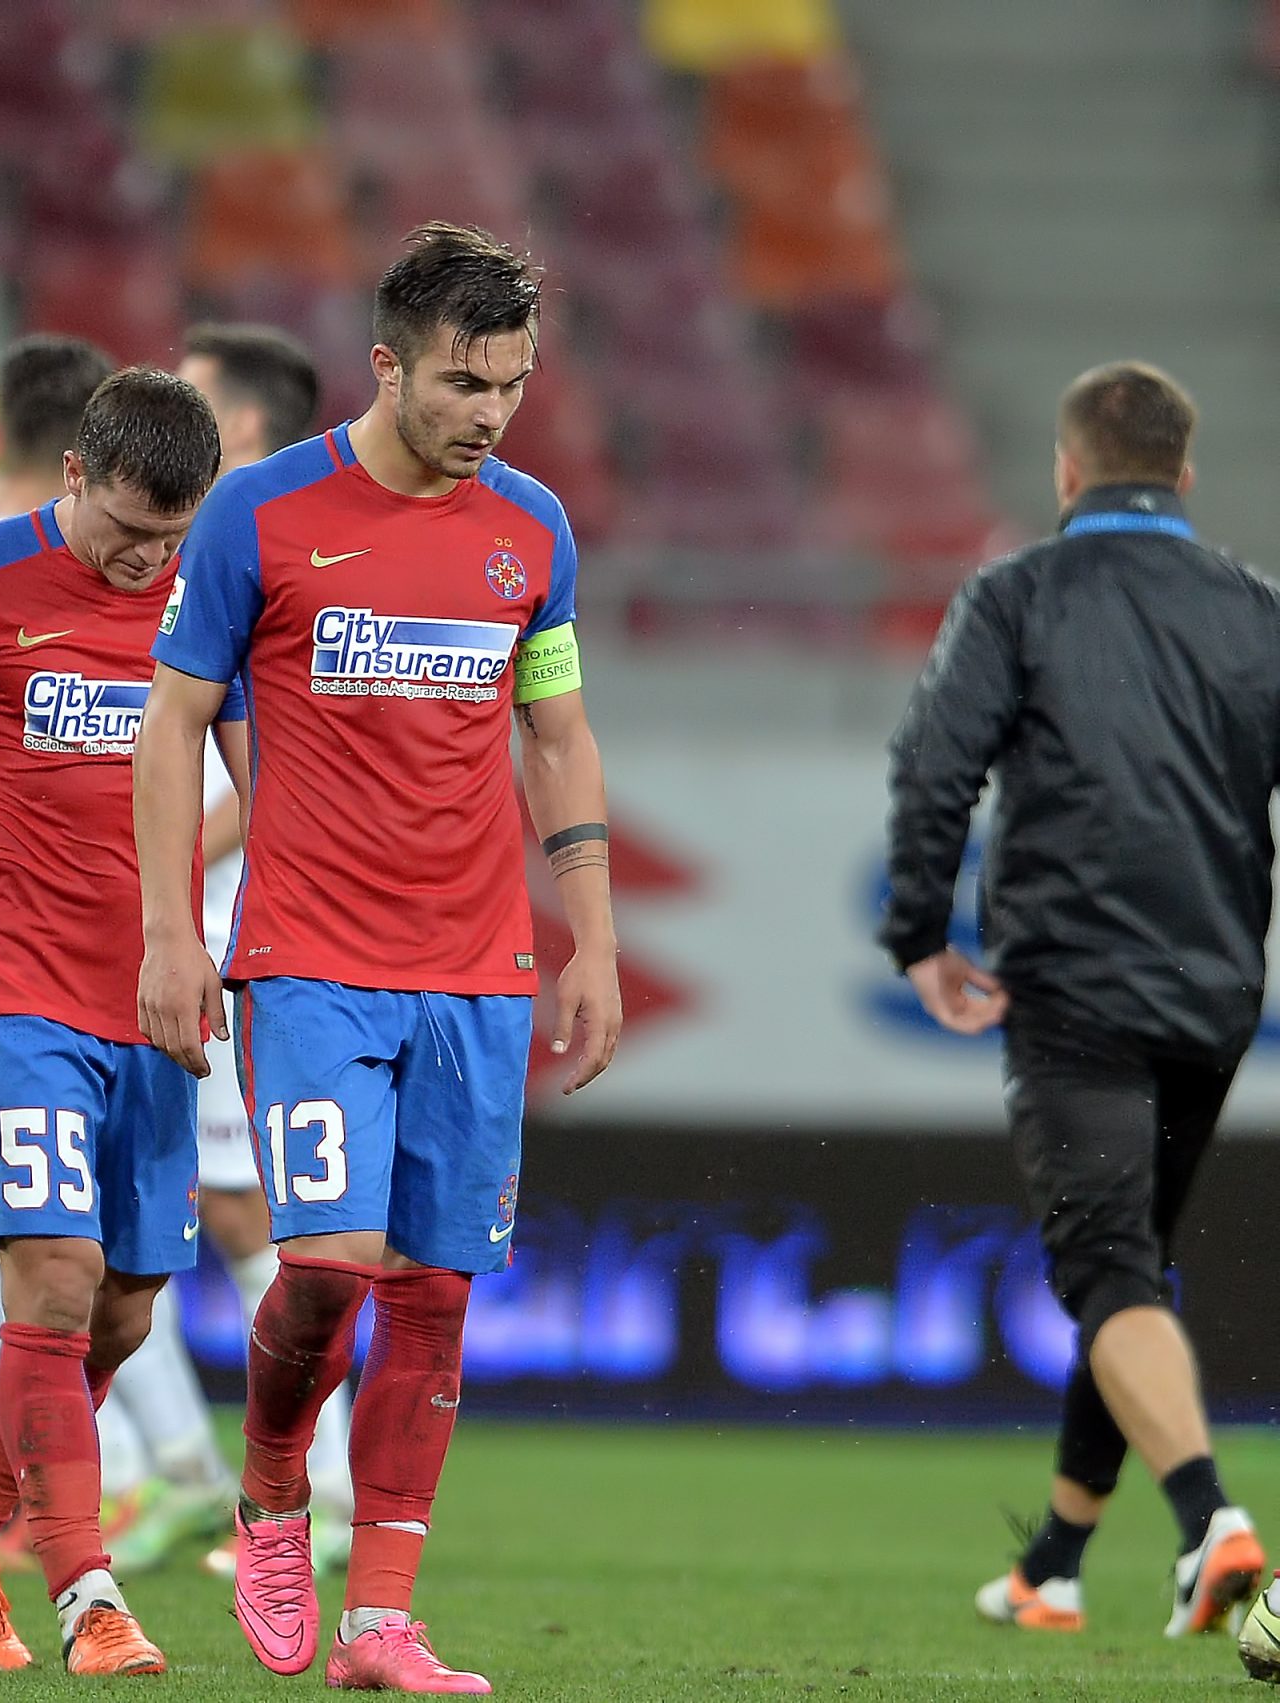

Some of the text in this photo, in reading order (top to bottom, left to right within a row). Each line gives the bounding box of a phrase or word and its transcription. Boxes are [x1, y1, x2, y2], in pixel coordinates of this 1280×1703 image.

[317, 611, 392, 652] City
[339, 650, 506, 681] Insurance
[524, 650, 540, 661] TO
[532, 661, 573, 680] RESPECT
[28, 676, 103, 716] City
[313, 681, 368, 694] Societate
[372, 682, 387, 694] de
[0, 1107, 94, 1213] 55
[266, 1100, 347, 1205] 13
